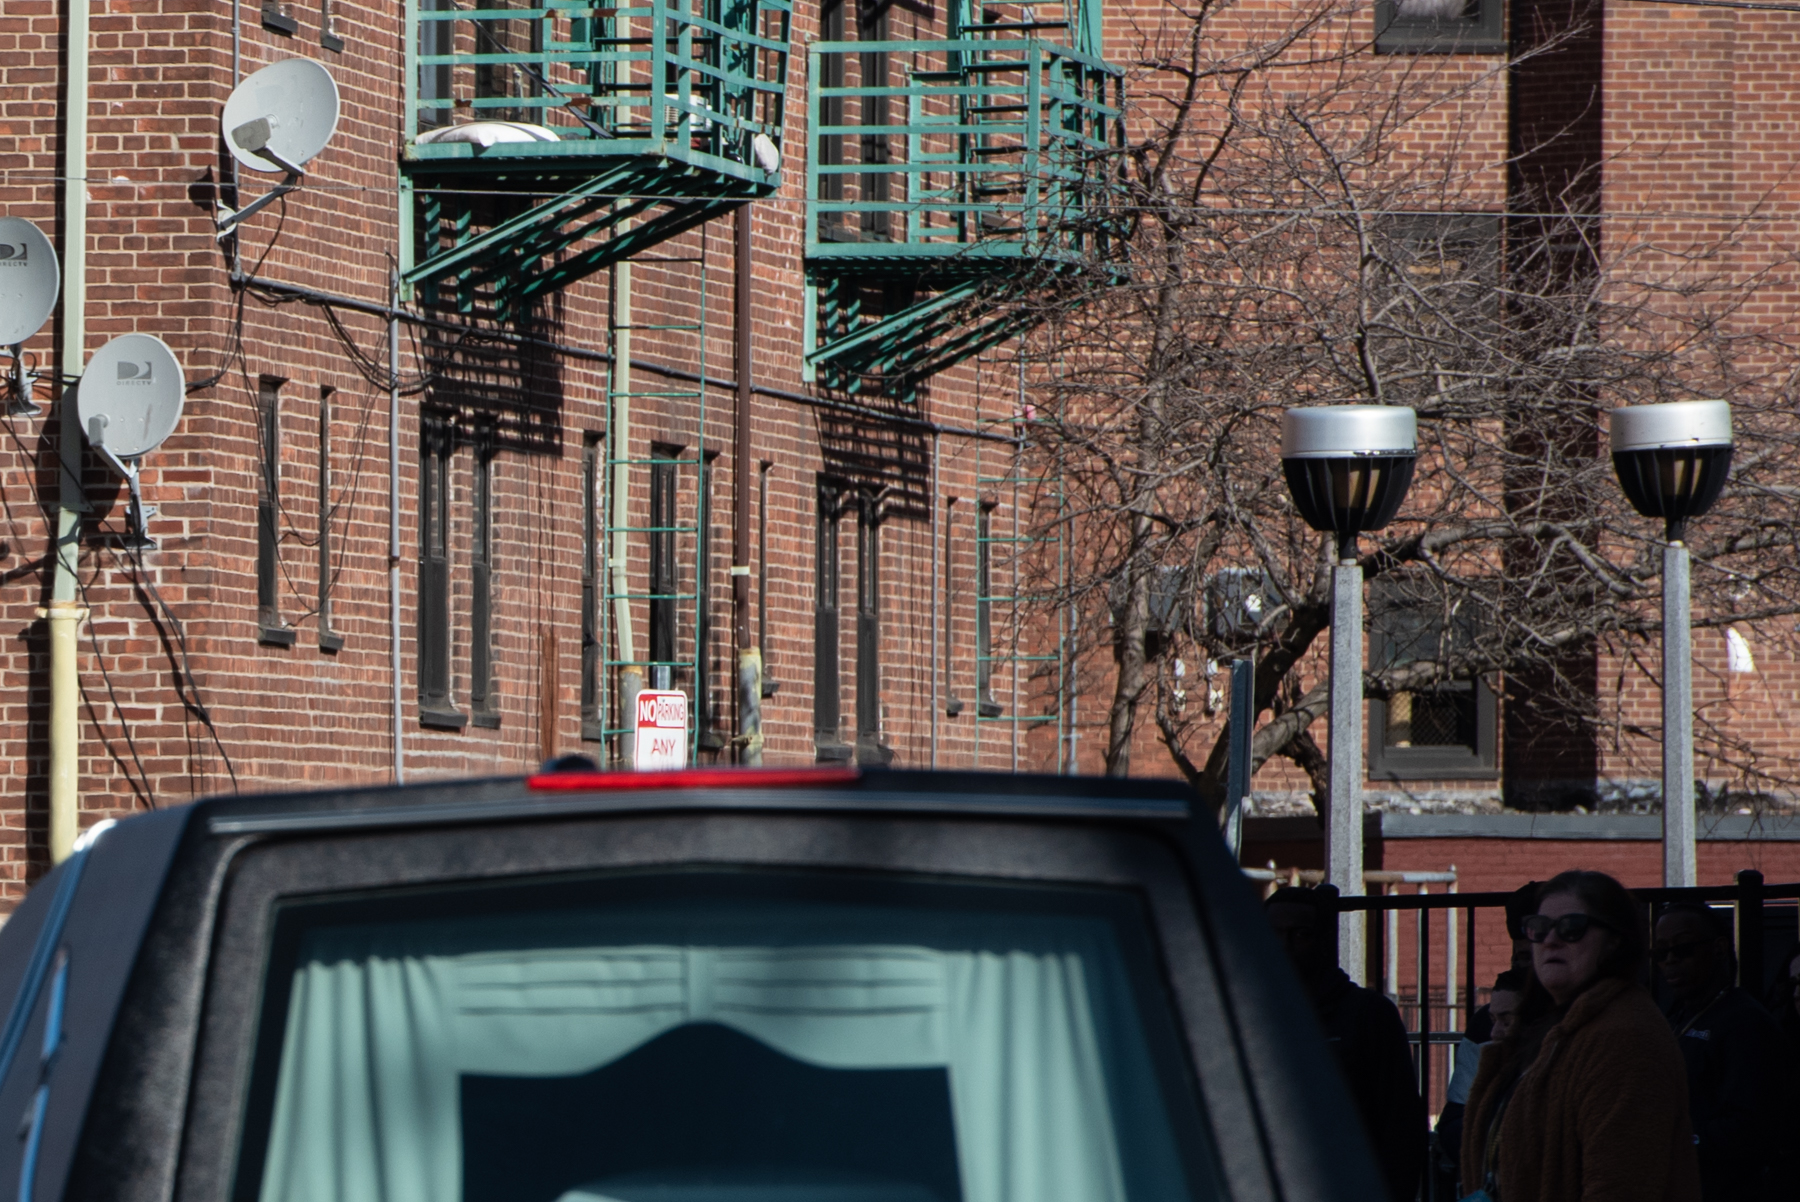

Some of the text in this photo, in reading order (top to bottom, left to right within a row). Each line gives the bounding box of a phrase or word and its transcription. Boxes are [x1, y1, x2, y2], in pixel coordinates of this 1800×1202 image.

[640, 700, 684, 722] NO PARKING
[651, 738, 676, 756] ANY
